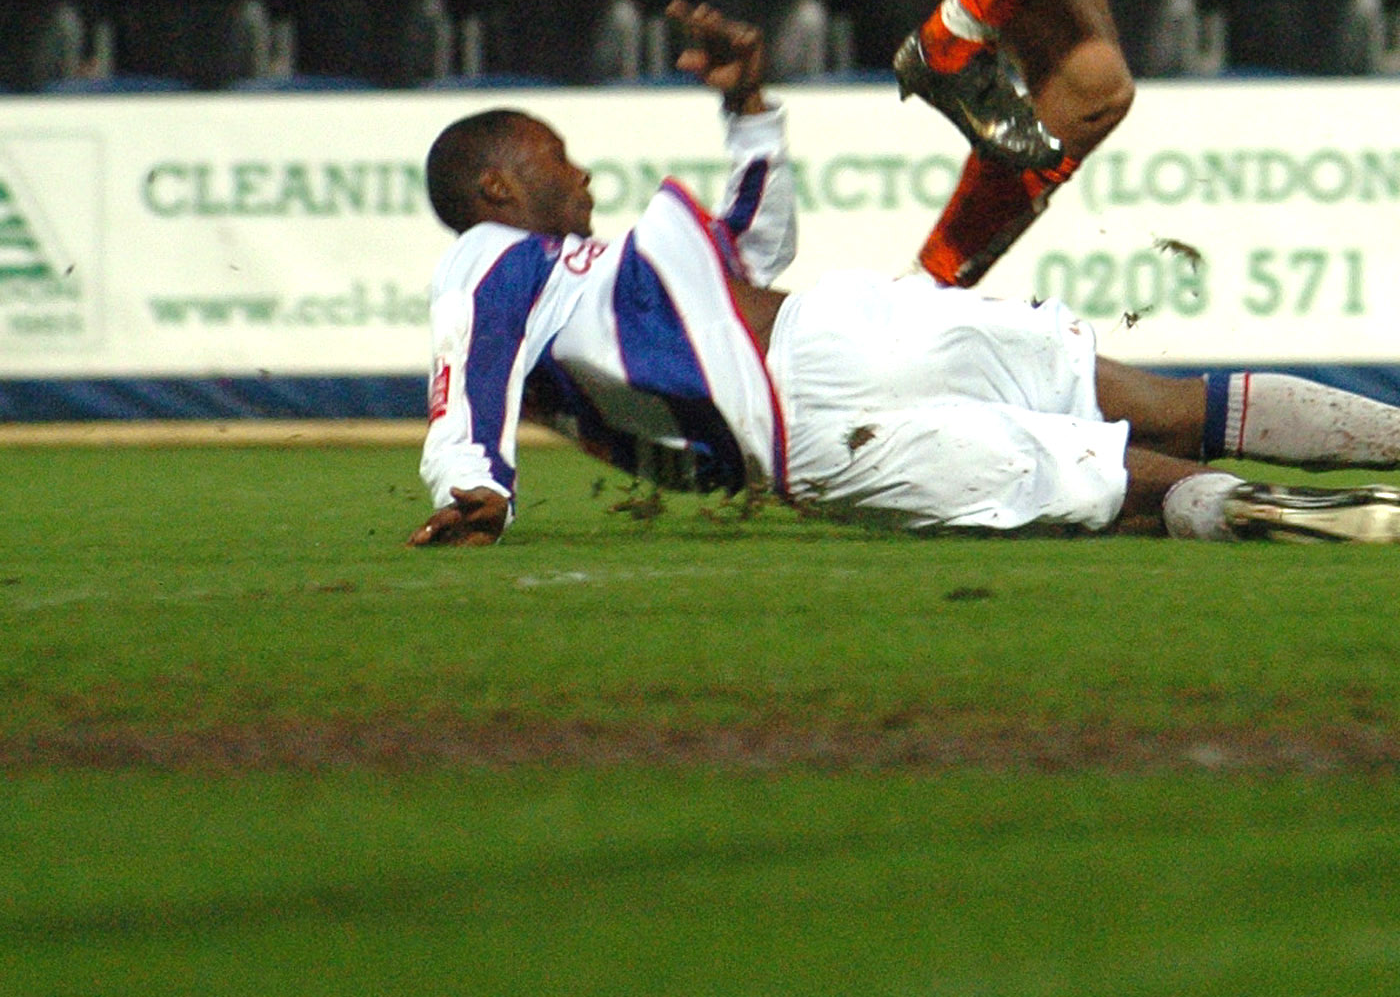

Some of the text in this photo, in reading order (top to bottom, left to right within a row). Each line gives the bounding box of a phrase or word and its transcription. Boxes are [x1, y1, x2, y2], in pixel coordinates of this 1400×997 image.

[141, 160, 427, 217] CLEANIN
[1036, 249, 1209, 317] 0208
[1243, 247, 1365, 317] 571
